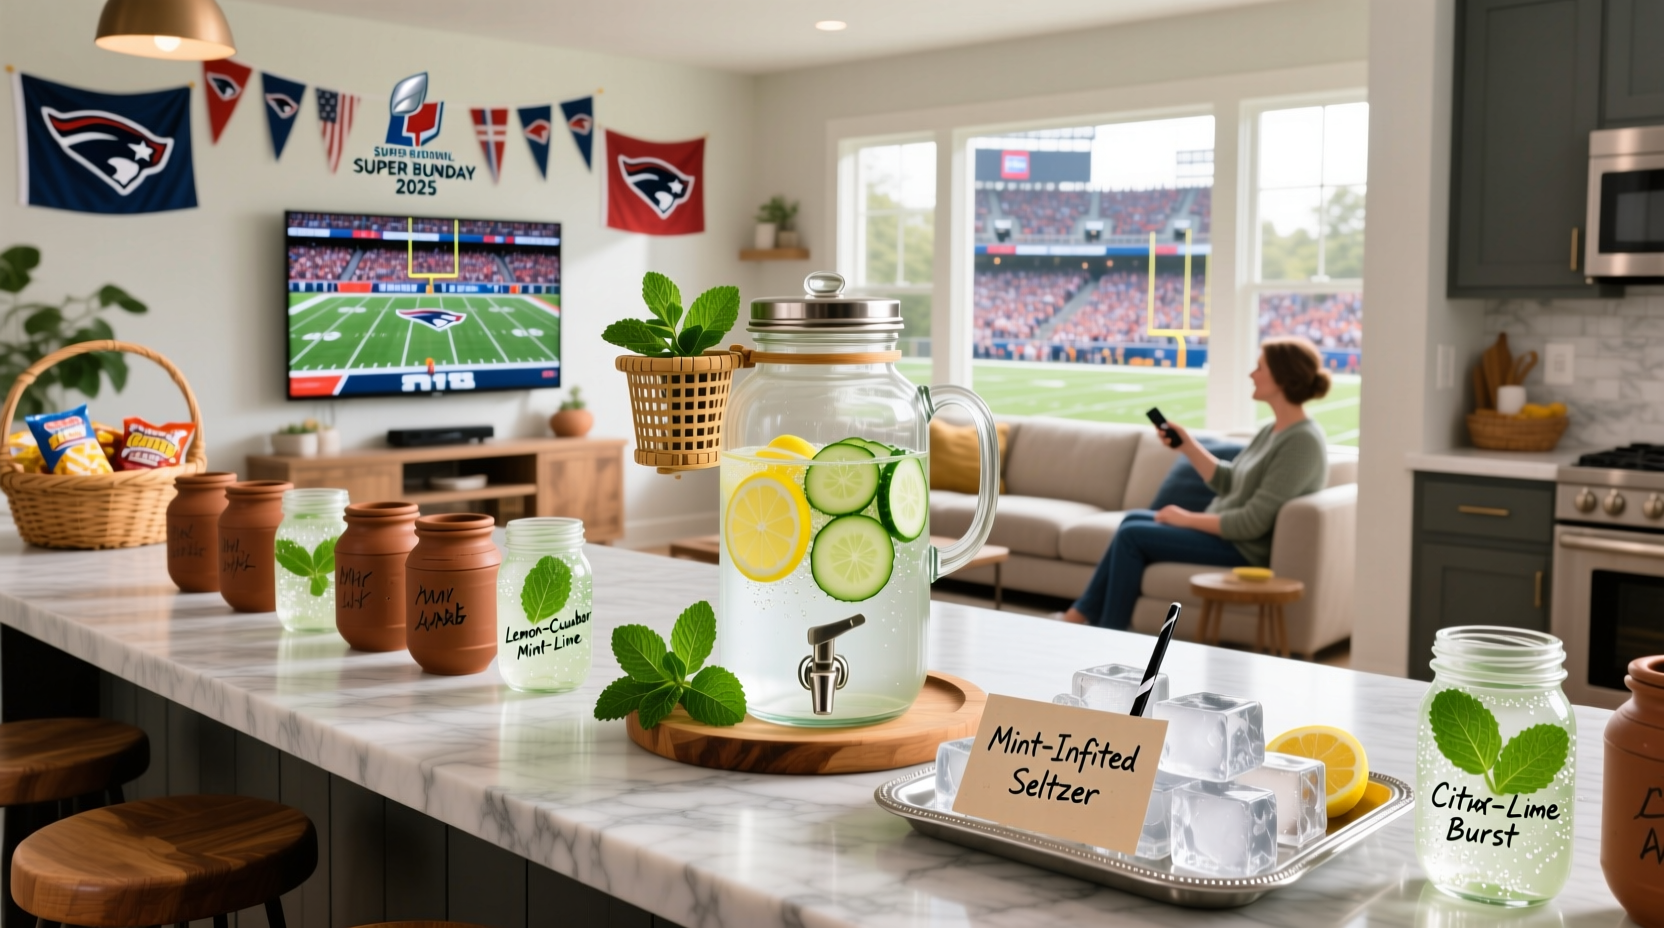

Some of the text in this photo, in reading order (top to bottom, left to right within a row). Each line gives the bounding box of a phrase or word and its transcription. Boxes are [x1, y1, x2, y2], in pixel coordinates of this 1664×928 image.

[353, 157, 408, 176] SUPER
[395, 178, 437, 196] 2025
[987, 725, 1141, 773] Mint-Infited
[1008, 767, 1100, 805] Seltzer
[1446, 816, 1520, 848] Burst
